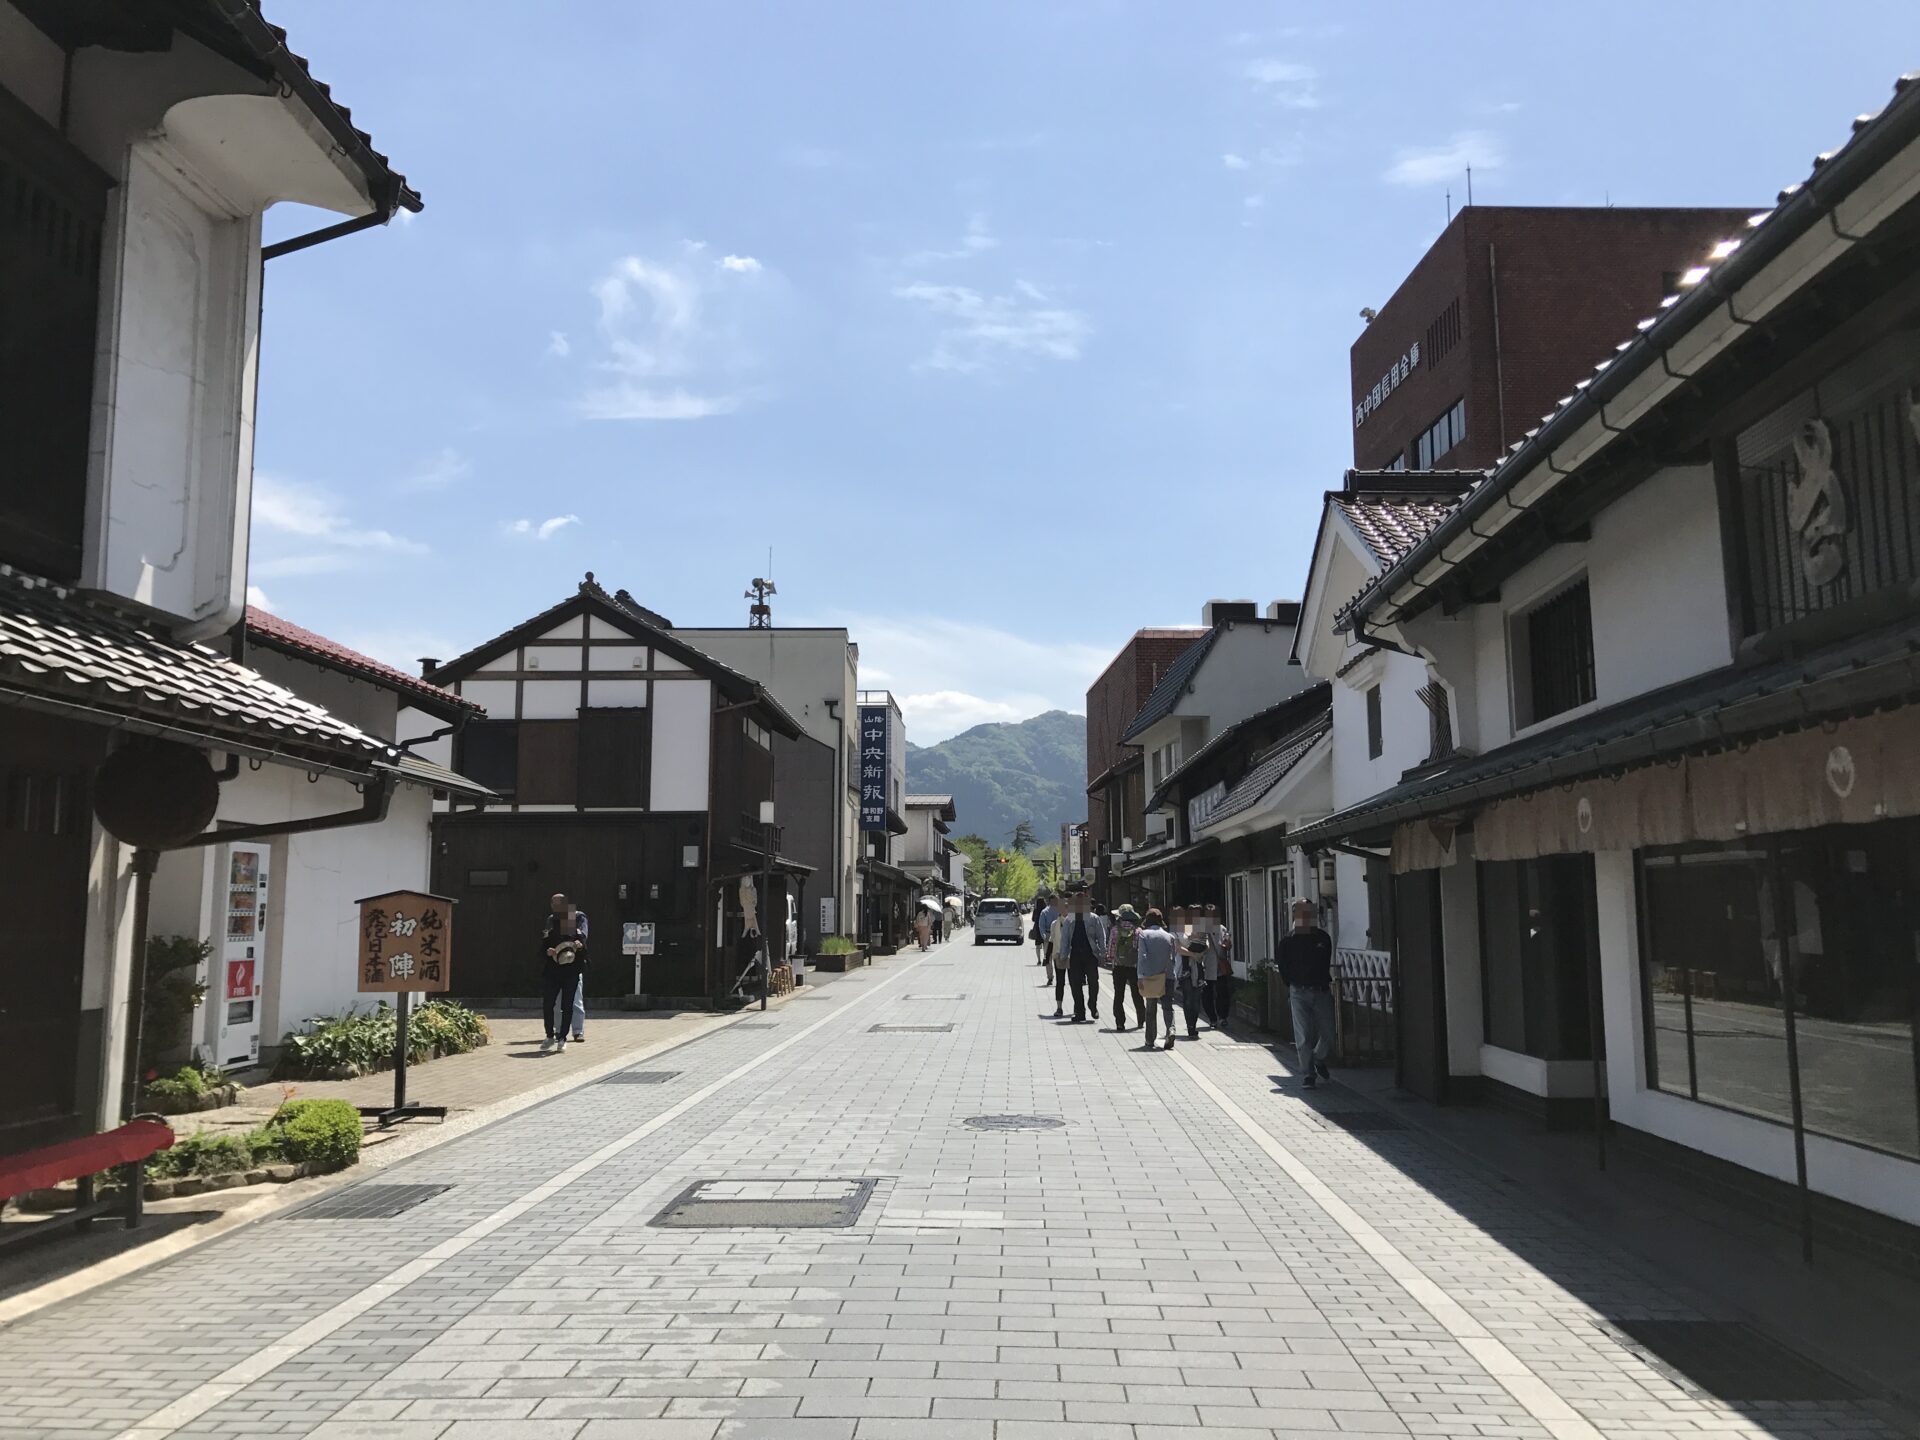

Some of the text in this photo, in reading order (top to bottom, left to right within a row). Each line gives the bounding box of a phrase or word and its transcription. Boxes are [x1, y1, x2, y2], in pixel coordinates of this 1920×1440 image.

[1355, 342, 1420, 428] 西中国信用金庫
[863, 728, 885, 801] 中央新報
[863, 807, 884, 815] 津和野
[388, 910, 418, 983] 初陣
[418, 908, 443, 983] 純米酒
[233, 987, 246, 996] FIRE
